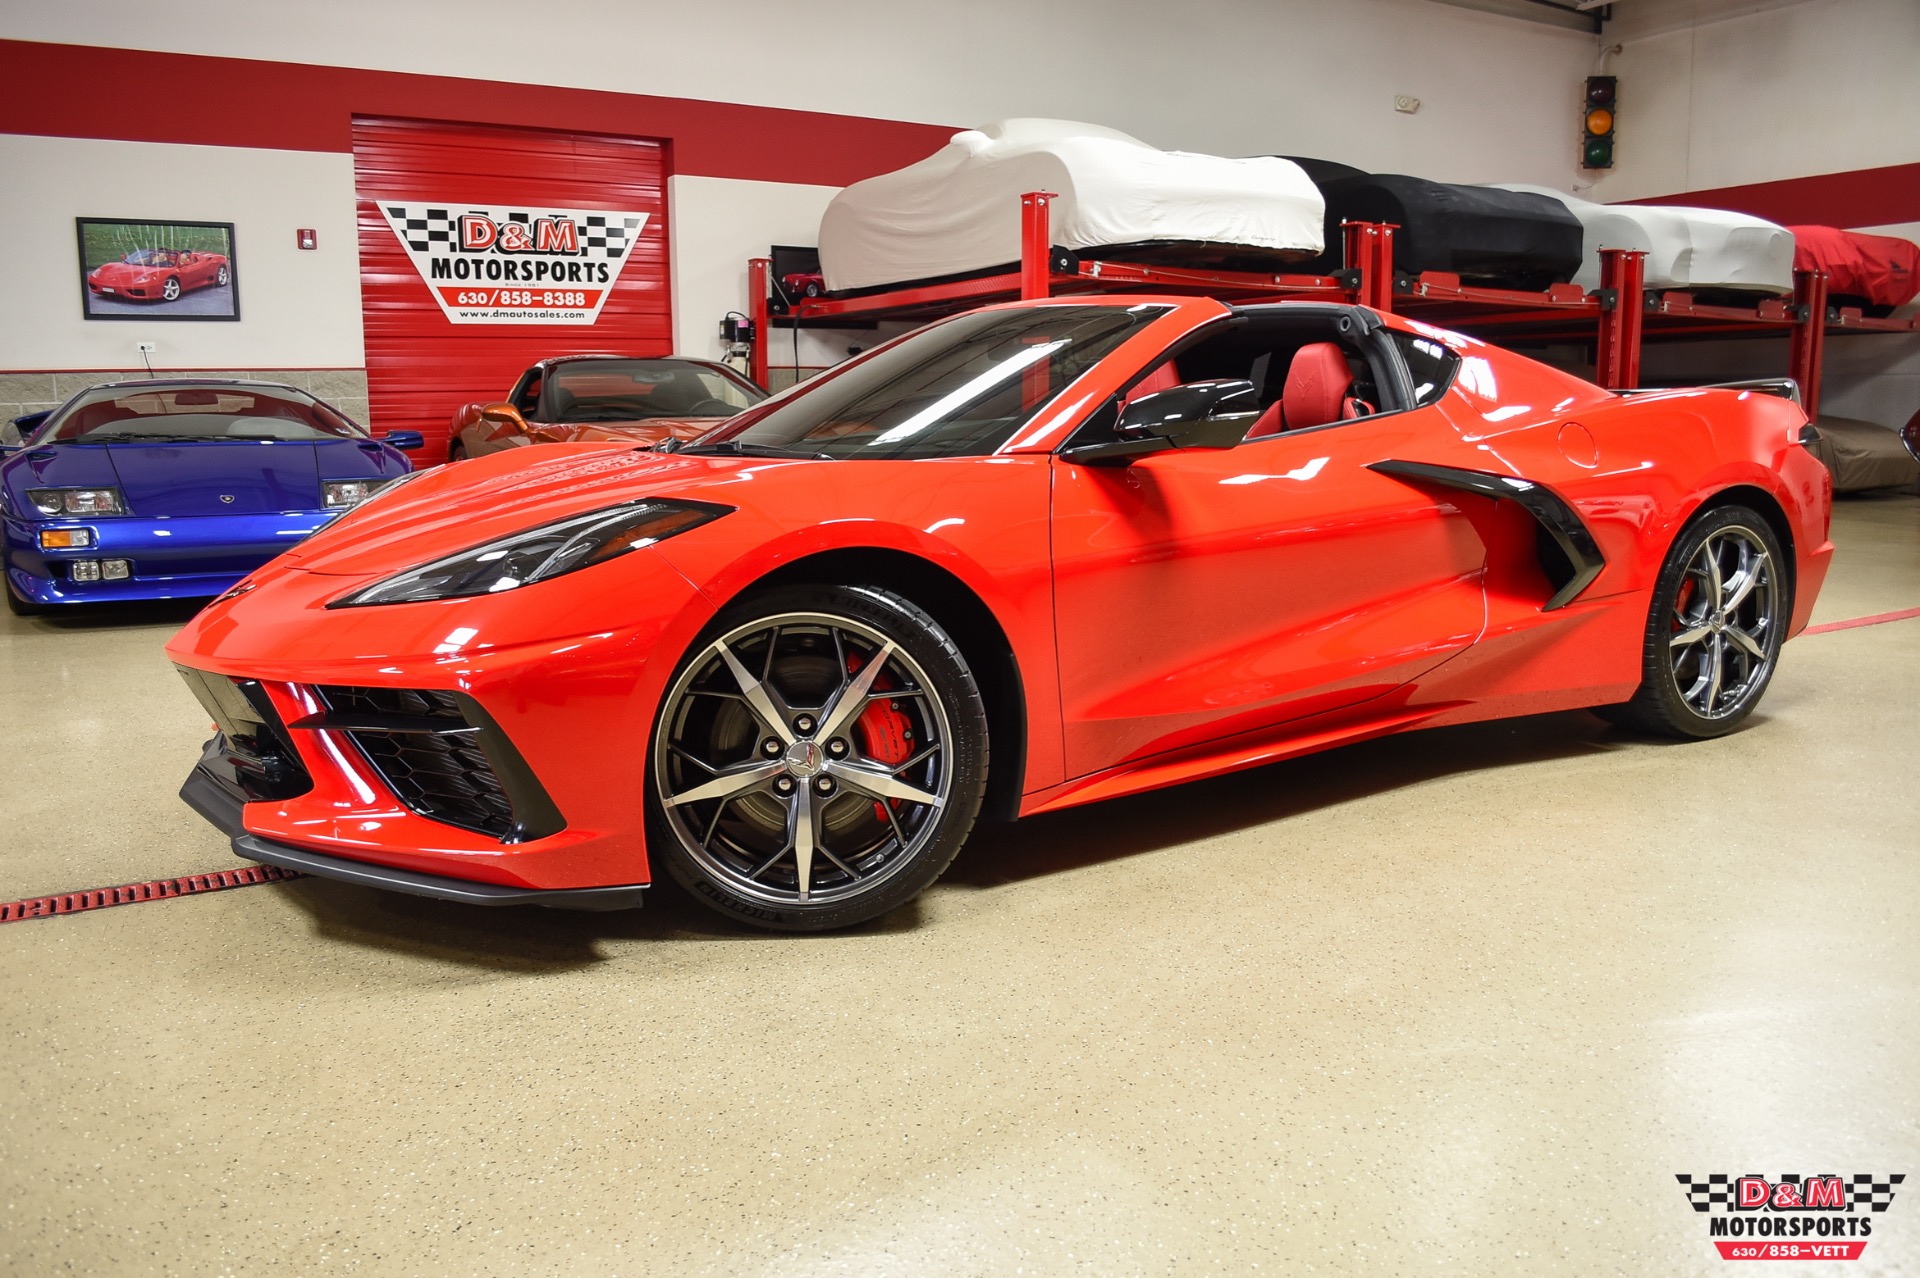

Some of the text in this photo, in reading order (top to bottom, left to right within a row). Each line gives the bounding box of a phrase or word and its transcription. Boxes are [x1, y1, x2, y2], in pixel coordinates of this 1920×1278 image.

[458, 214, 583, 257] D&M
[431, 257, 609, 284] MOTORSPORTS
[457, 290, 586, 306] 630/858-8388
[459, 309, 585, 320] www.dmautosales.com
